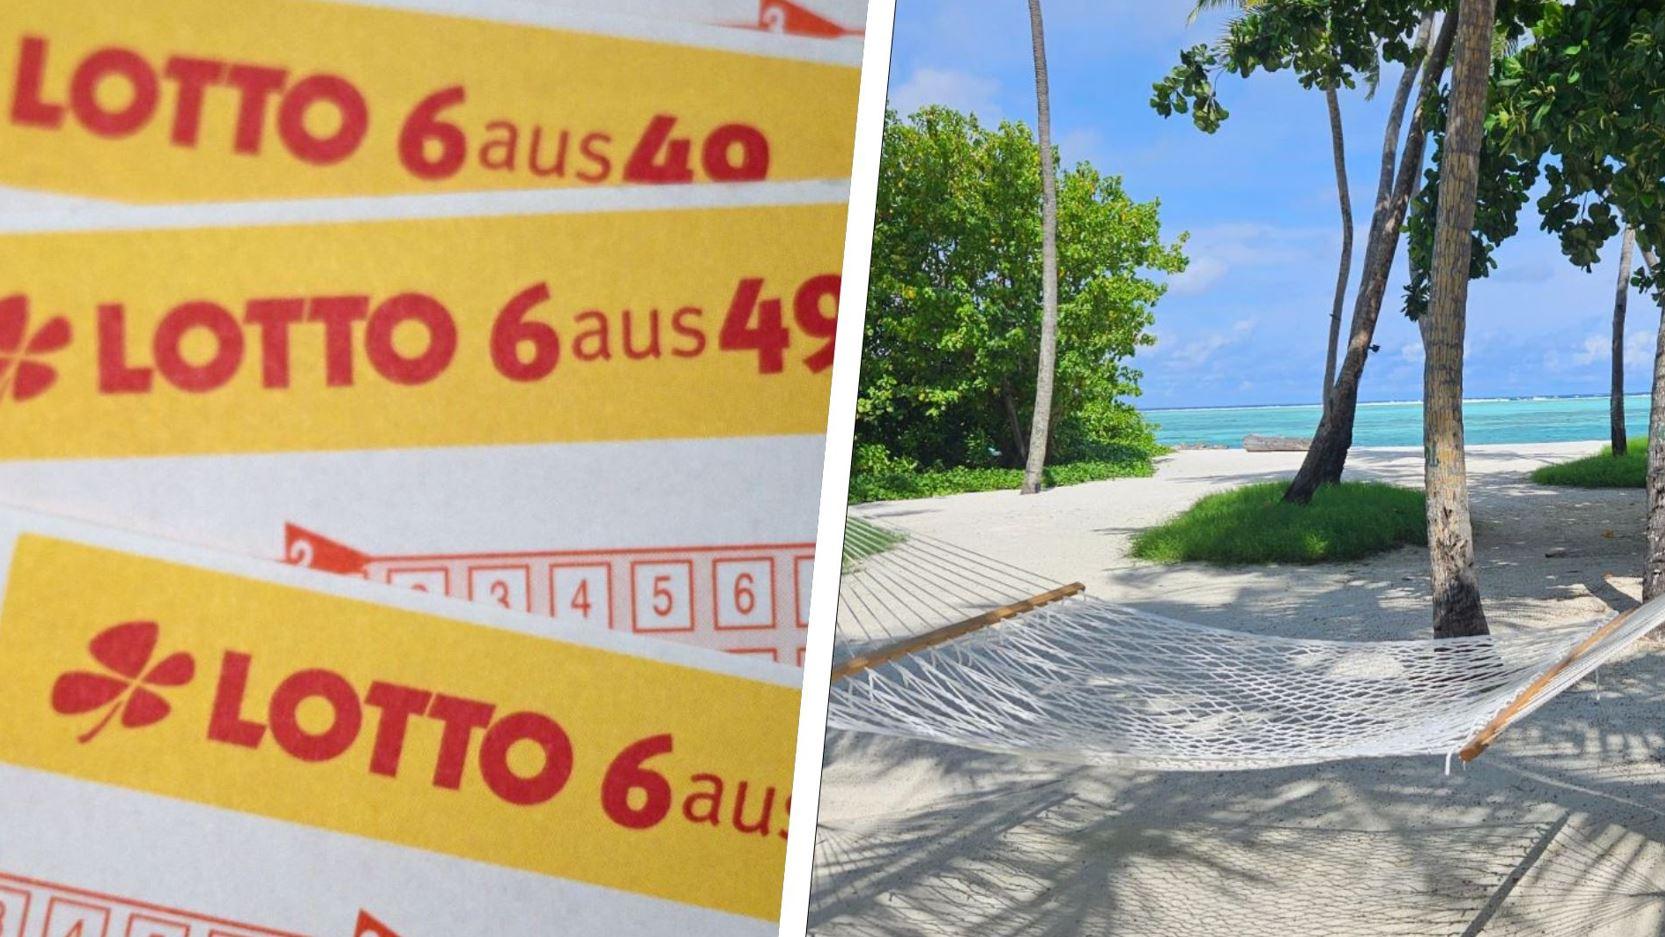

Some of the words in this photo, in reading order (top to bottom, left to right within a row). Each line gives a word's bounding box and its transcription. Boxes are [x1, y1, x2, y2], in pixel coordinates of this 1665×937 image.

[10, 36, 369, 166] LOTTO
[97, 292, 457, 394] LOTTO
[570, 579, 591, 618] 4
[653, 576, 673, 616] 5
[734, 573, 755, 614] 6
[206, 650, 573, 806] LOTTO
